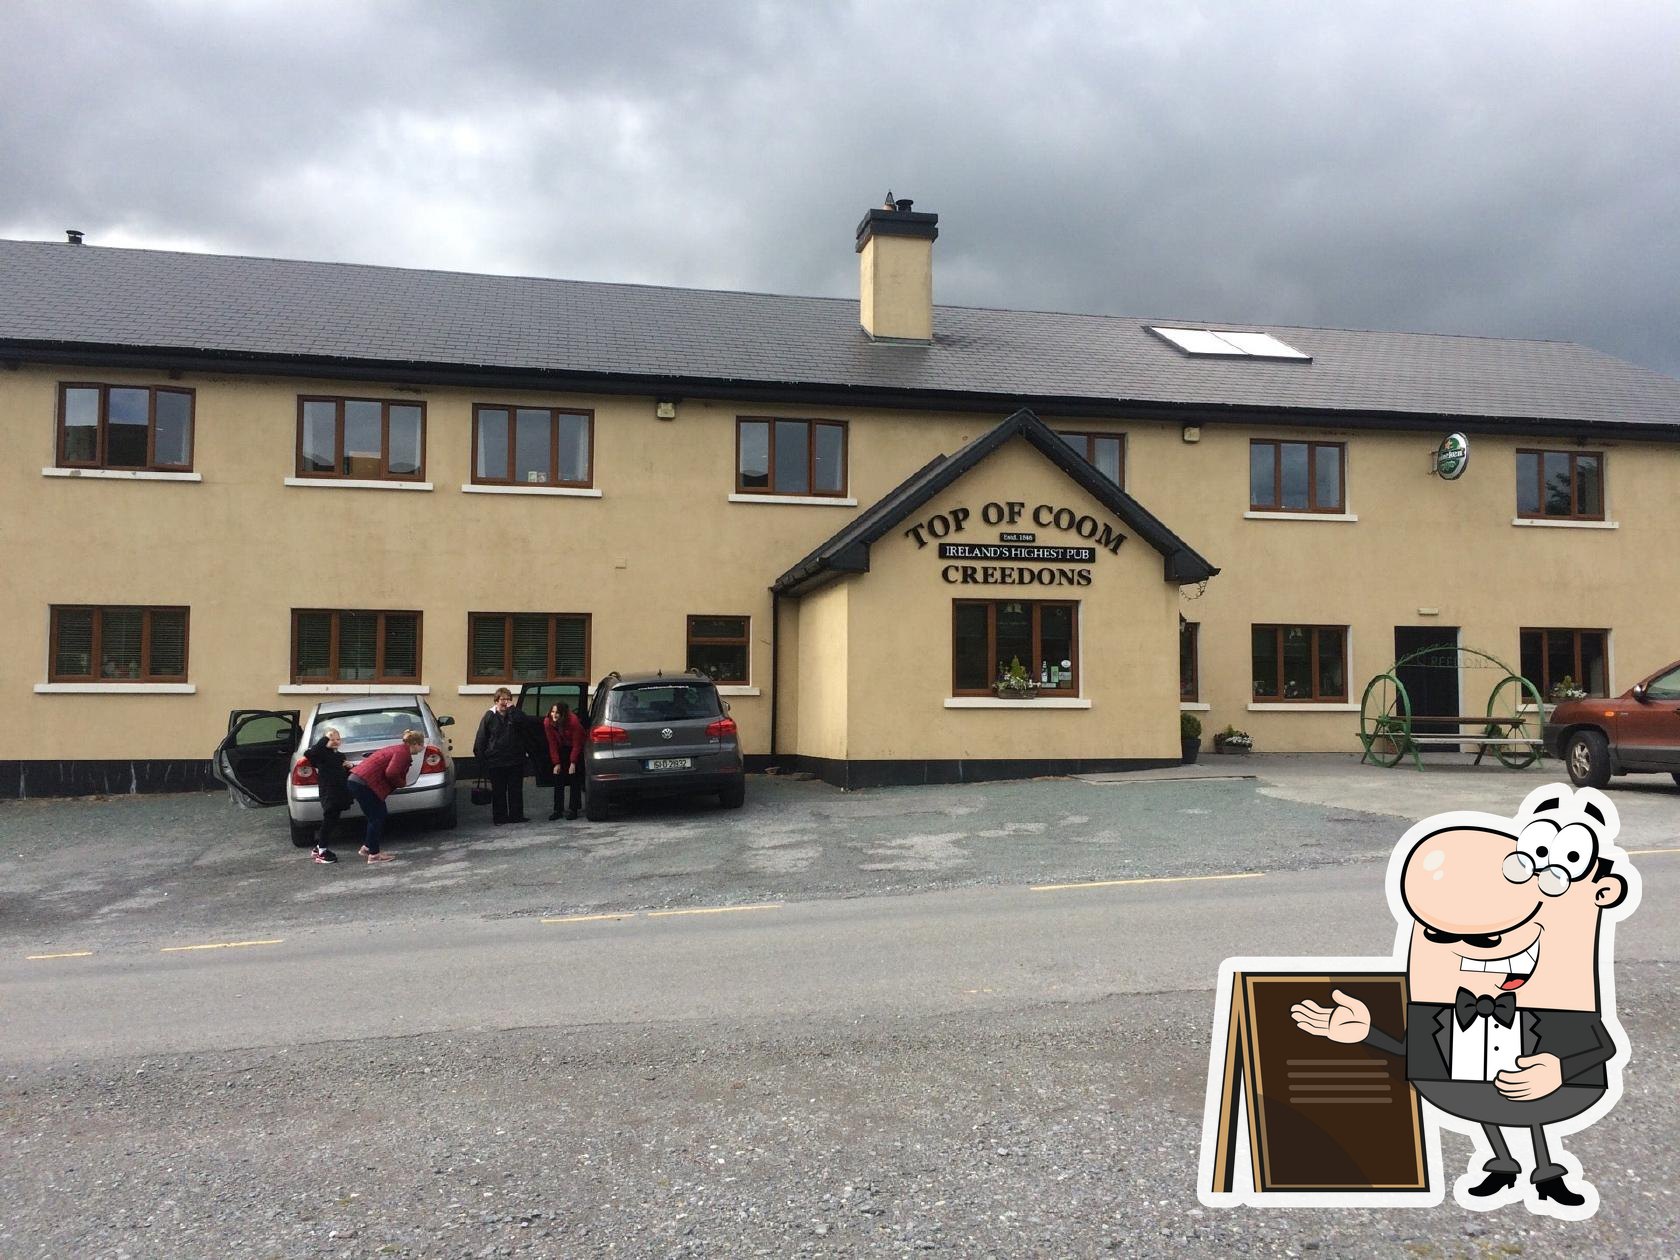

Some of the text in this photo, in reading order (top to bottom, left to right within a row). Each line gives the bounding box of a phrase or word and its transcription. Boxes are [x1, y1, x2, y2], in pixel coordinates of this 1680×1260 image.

[904, 501, 1128, 555] TOP OF COOM
[946, 546, 1090, 560] IRELAND'S HIGHEST PUB
[941, 564, 1092, 587] CREEDONS
